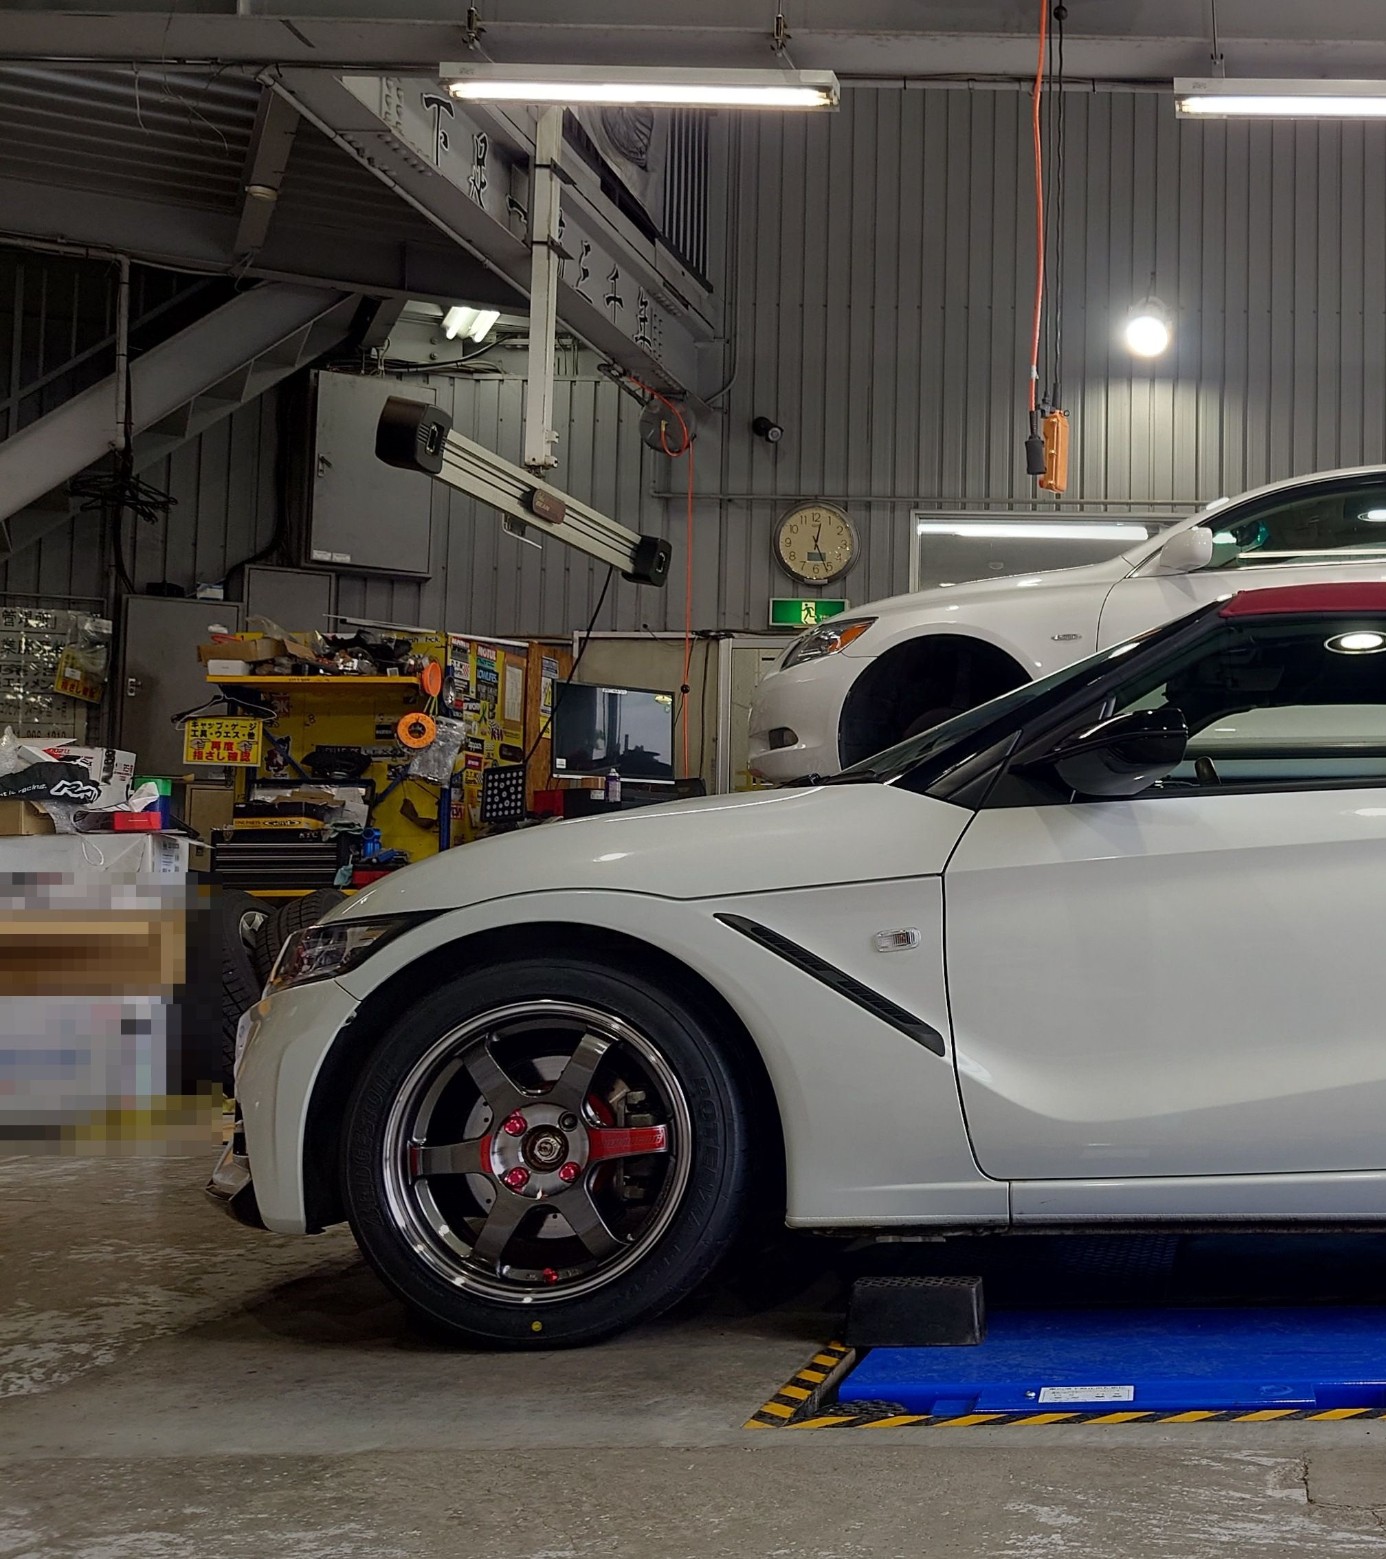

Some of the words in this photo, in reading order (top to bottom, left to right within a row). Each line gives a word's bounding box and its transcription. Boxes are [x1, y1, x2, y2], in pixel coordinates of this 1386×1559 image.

[800, 515, 807, 525] 11
[811, 513, 820, 523] 12
[828, 516, 831, 526] 1
[789, 524, 799, 534] 10
[836, 526, 844, 536] 2
[785, 538, 792, 547] 9
[840, 540, 848, 549] 3
[788, 551, 796, 561] 8
[800, 561, 806, 571] 7
[812, 565, 820, 574] 6
[826, 562, 833, 571] 5
[478, 646, 496, 661] MOTUL
